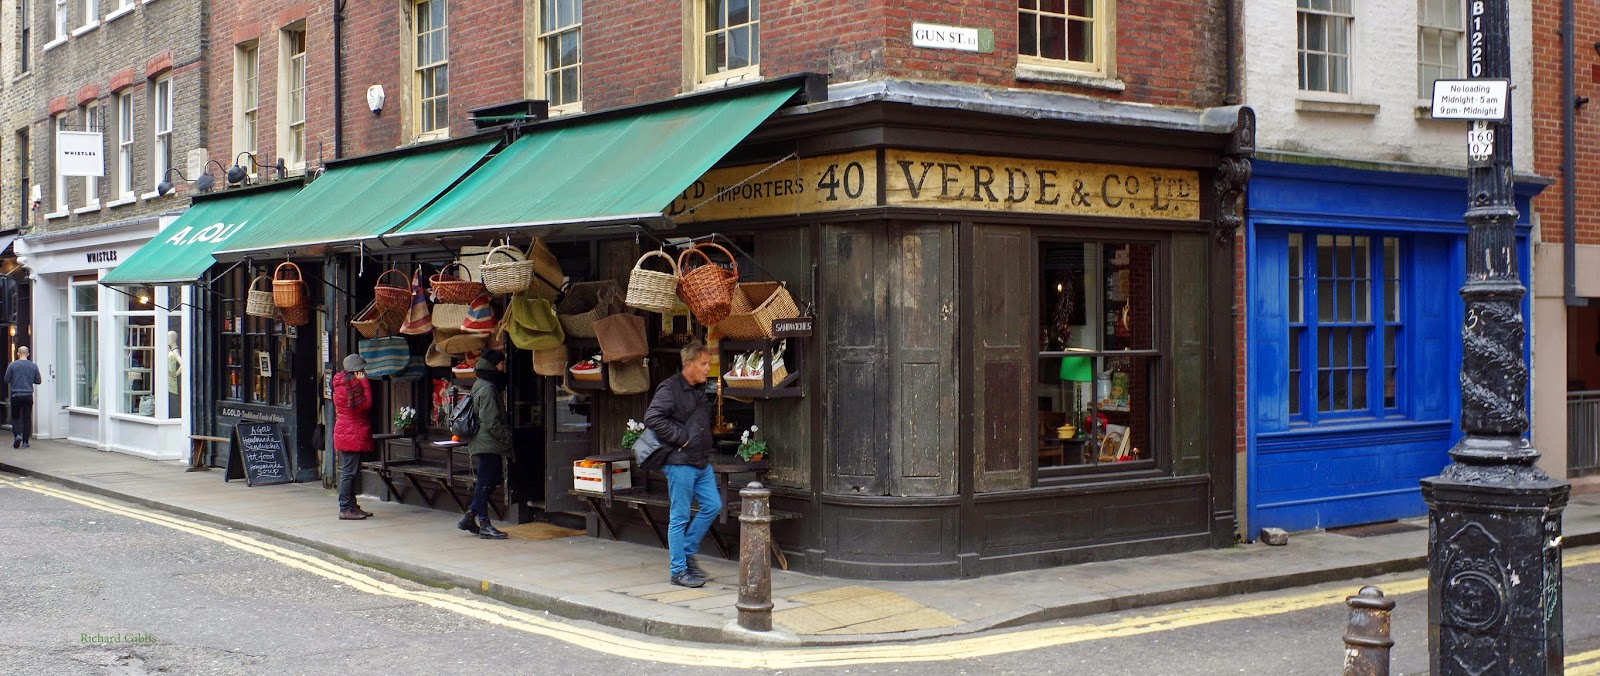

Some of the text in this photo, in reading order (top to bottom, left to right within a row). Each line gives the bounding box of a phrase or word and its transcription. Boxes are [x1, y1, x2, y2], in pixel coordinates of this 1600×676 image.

[915, 29, 945, 42] GUN
[949, 31, 966, 44] ST.
[1450, 85, 1490, 94] No loading
[1441, 96, 1474, 105] Midnight
[1480, 96, 1485, 104] 5
[1463, 107, 1497, 116] Midnight
[717, 178, 804, 203] IMPORTERS
[817, 161, 865, 201] 40
[897, 160, 1061, 205] VERDE
[1071, 178, 1092, 207] &
[86, 250, 117, 263] WHISTLES
